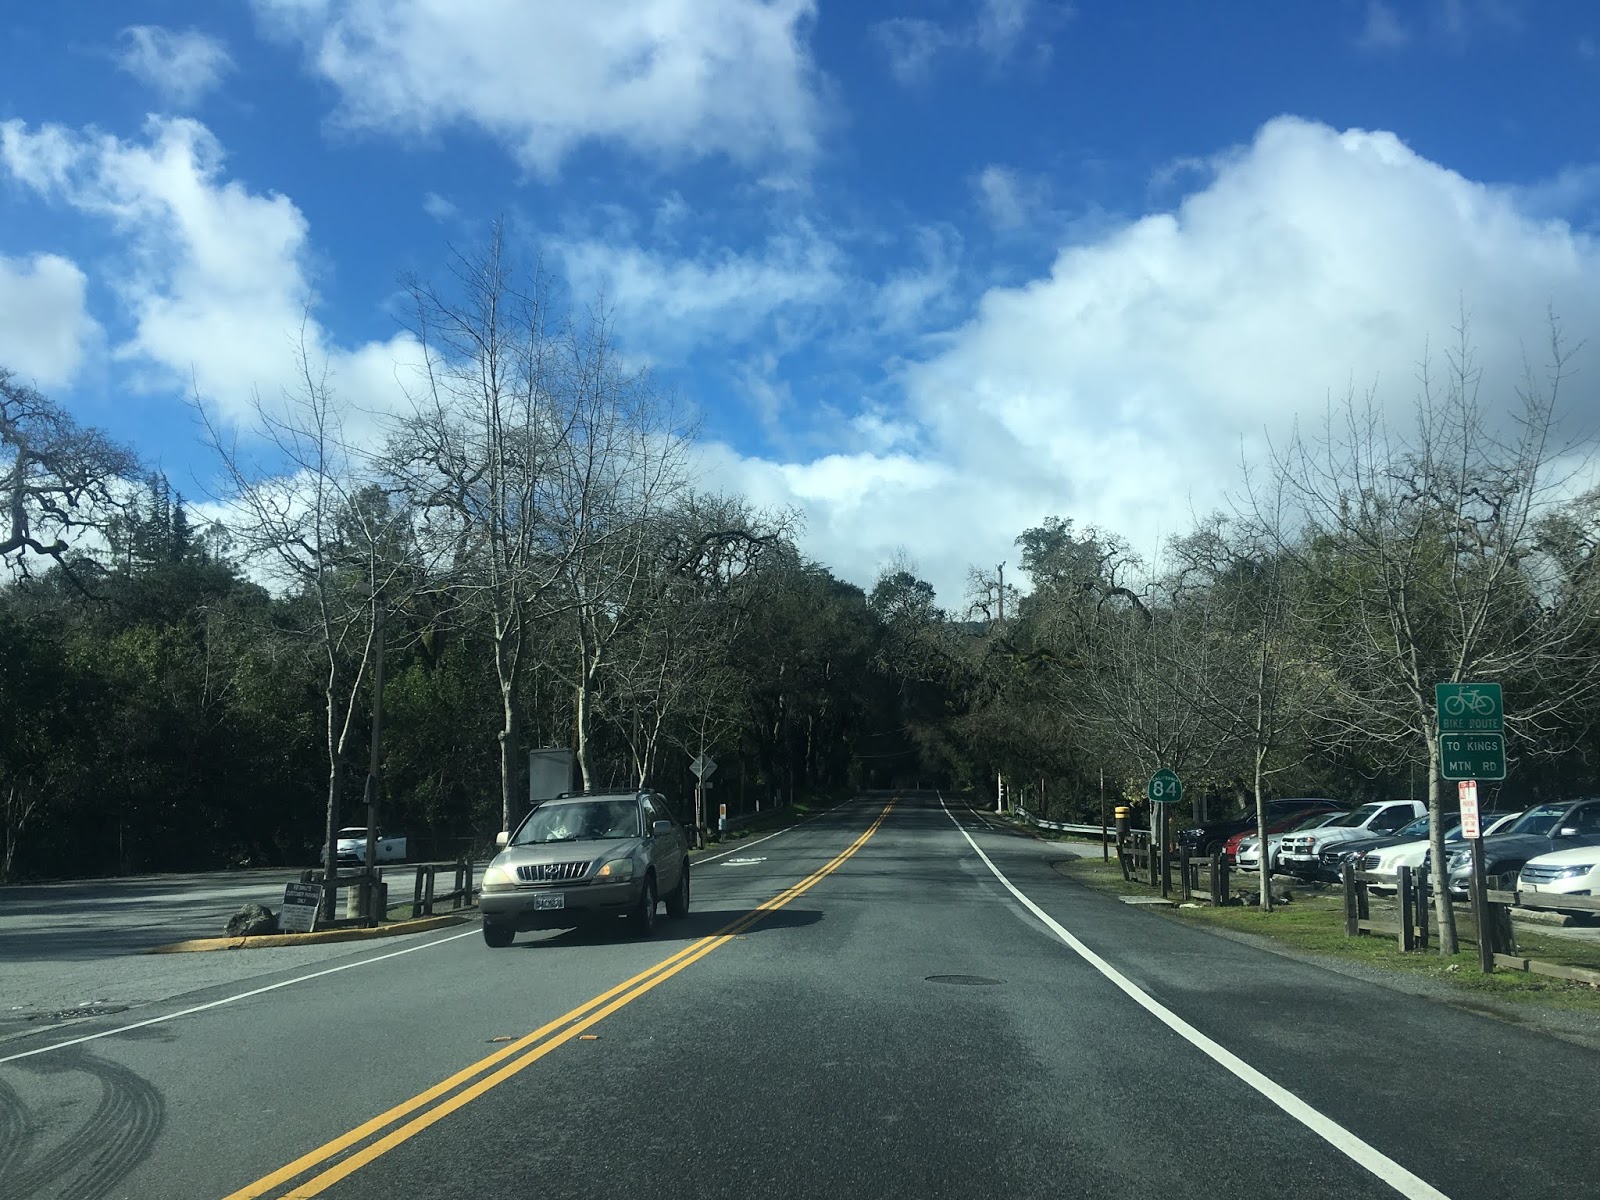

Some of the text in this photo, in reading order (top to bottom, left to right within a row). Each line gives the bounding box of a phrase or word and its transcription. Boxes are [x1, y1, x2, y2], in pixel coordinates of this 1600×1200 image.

[1443, 719, 1499, 728] BIKE ROUTE
[1446, 741, 1498, 751] TO KINGS
[1449, 761, 1497, 771] MTN RD
[1153, 780, 1177, 797] 84
